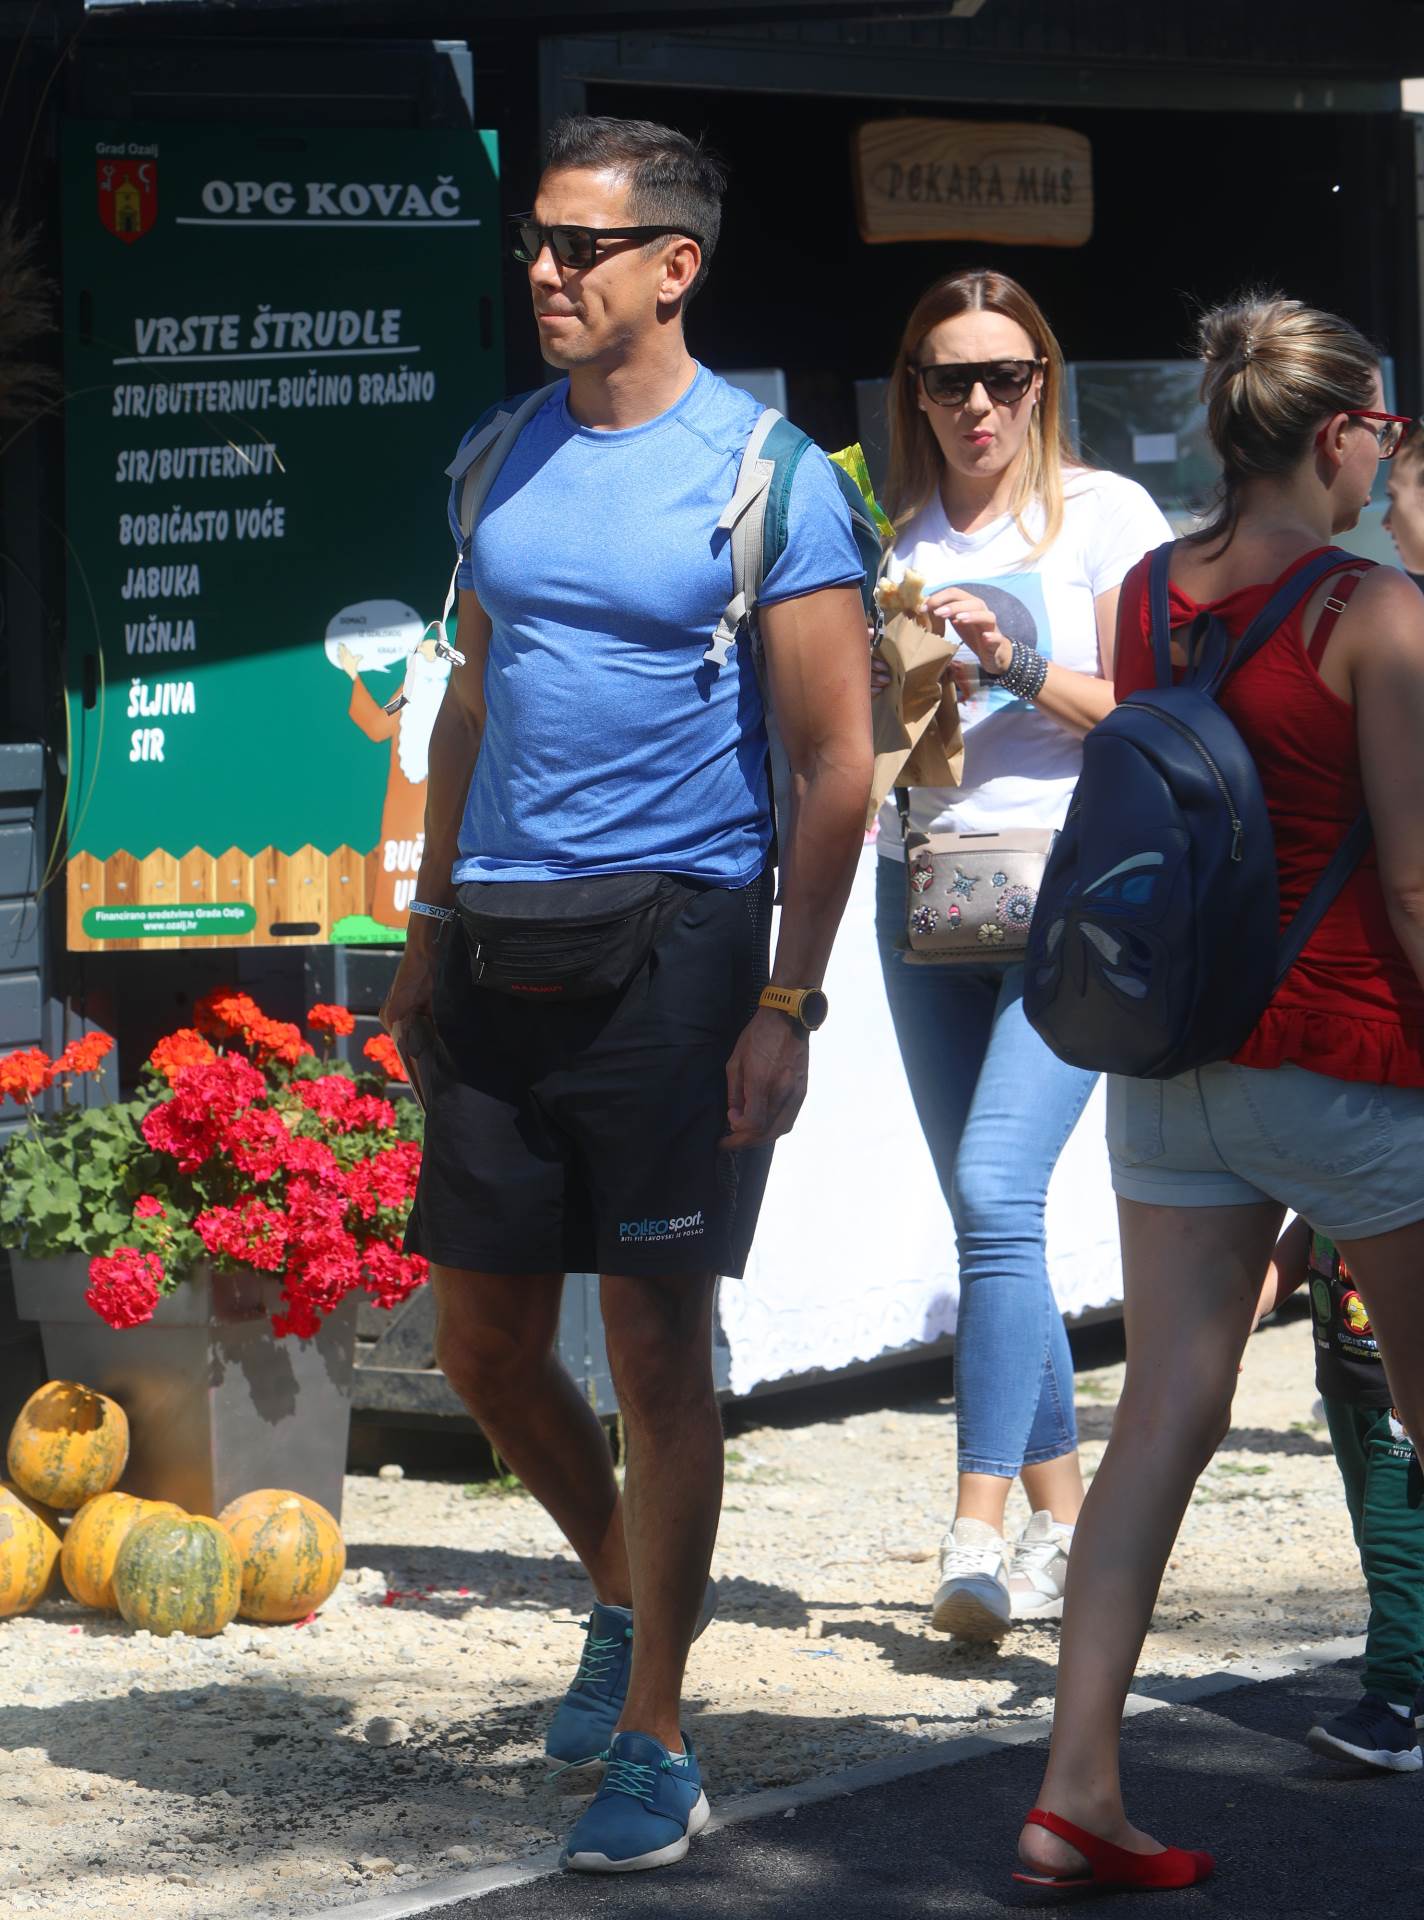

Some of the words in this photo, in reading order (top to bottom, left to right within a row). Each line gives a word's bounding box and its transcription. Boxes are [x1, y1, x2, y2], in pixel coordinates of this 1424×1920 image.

[96, 142, 125, 155] Grad
[128, 143, 158, 158] Ozalj
[202, 180, 296, 214] OPG
[306, 175, 460, 217] KOVAČ
[134, 315, 239, 356] VRSTE
[251, 304, 401, 350] ŠTRUDLE
[113, 368, 352, 418] SIR/BUTTERNUT-BUČINO
[359, 365, 435, 407] BRAŠNO
[116, 443, 276, 485] SIR/BUTTERNUT
[119, 506, 228, 546] BOBIČASTO
[236, 500, 285, 539] VOĆE
[122, 565, 199, 599] JABUKA
[125, 615, 196, 655] VIŠNJA
[127, 677, 195, 718] ŠLJIVA
[130, 728, 165, 762] SIR
